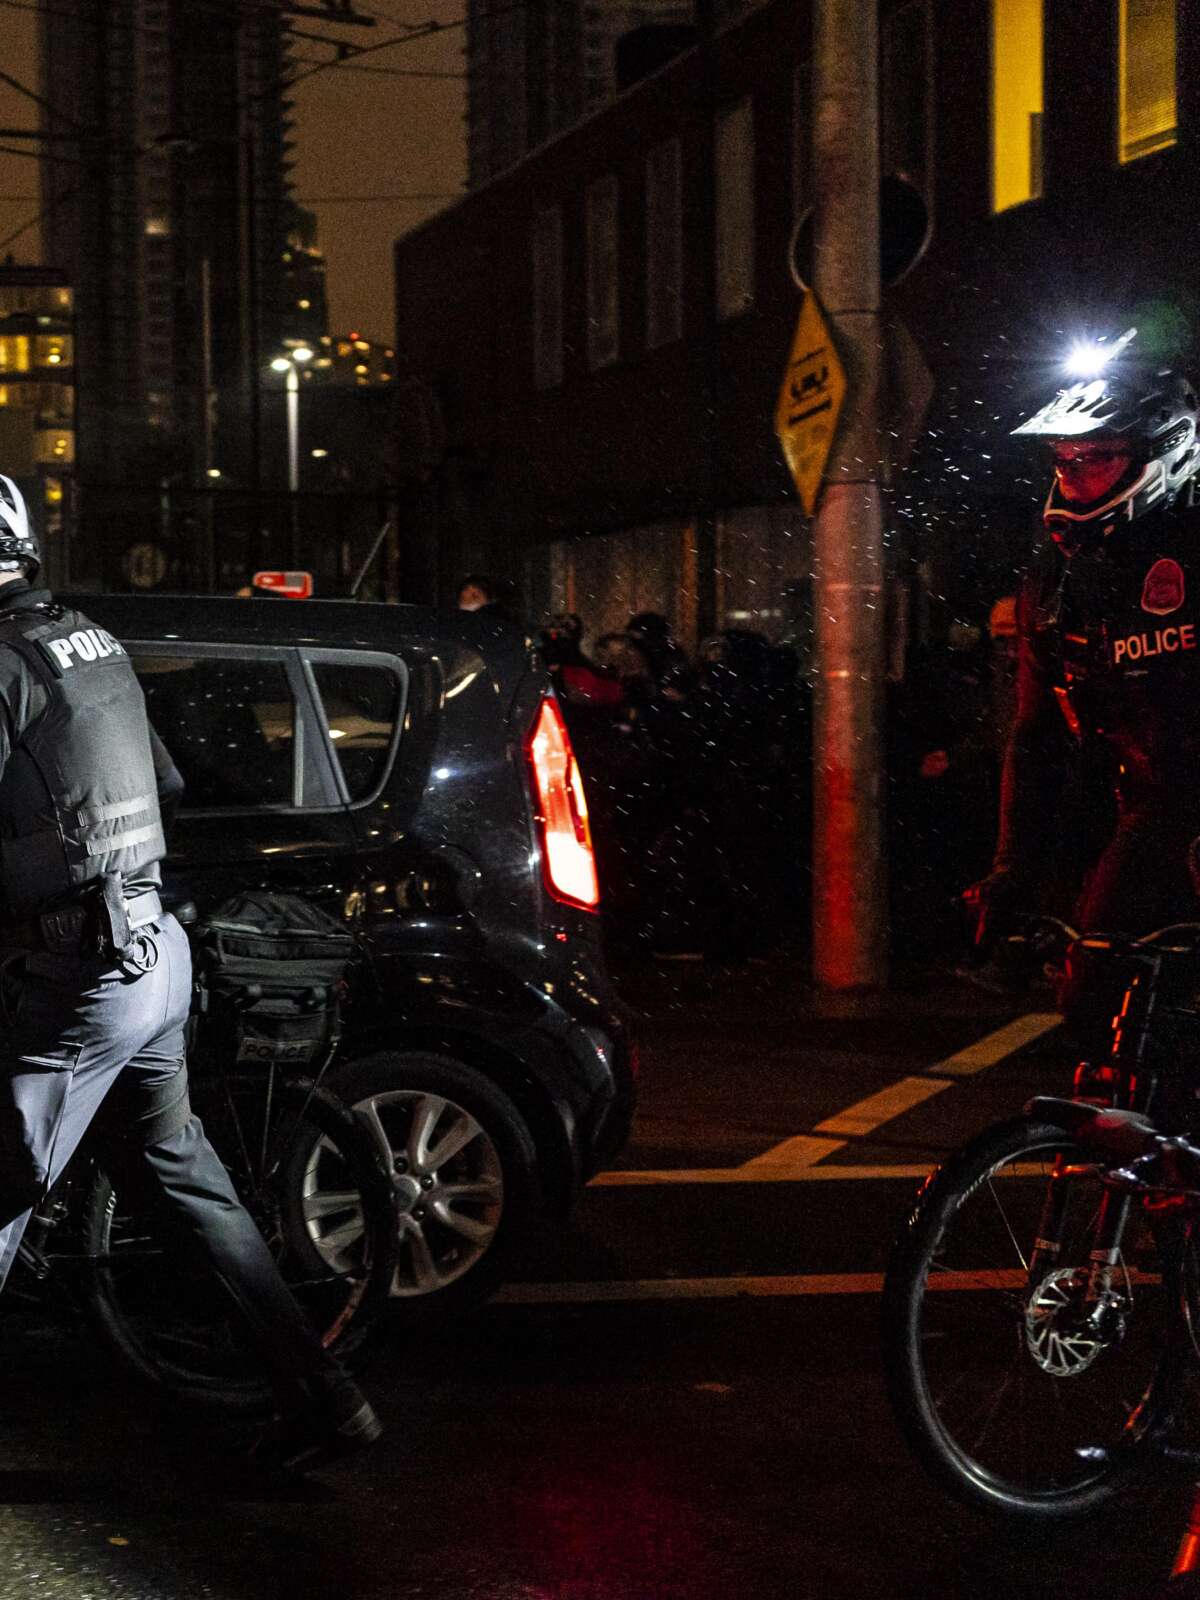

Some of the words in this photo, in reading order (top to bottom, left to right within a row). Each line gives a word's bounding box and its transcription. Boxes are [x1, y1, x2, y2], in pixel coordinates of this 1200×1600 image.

[47, 628, 128, 670] POLIC
[1113, 623, 1198, 665] POLICE
[243, 1043, 308, 1058] POLICE
